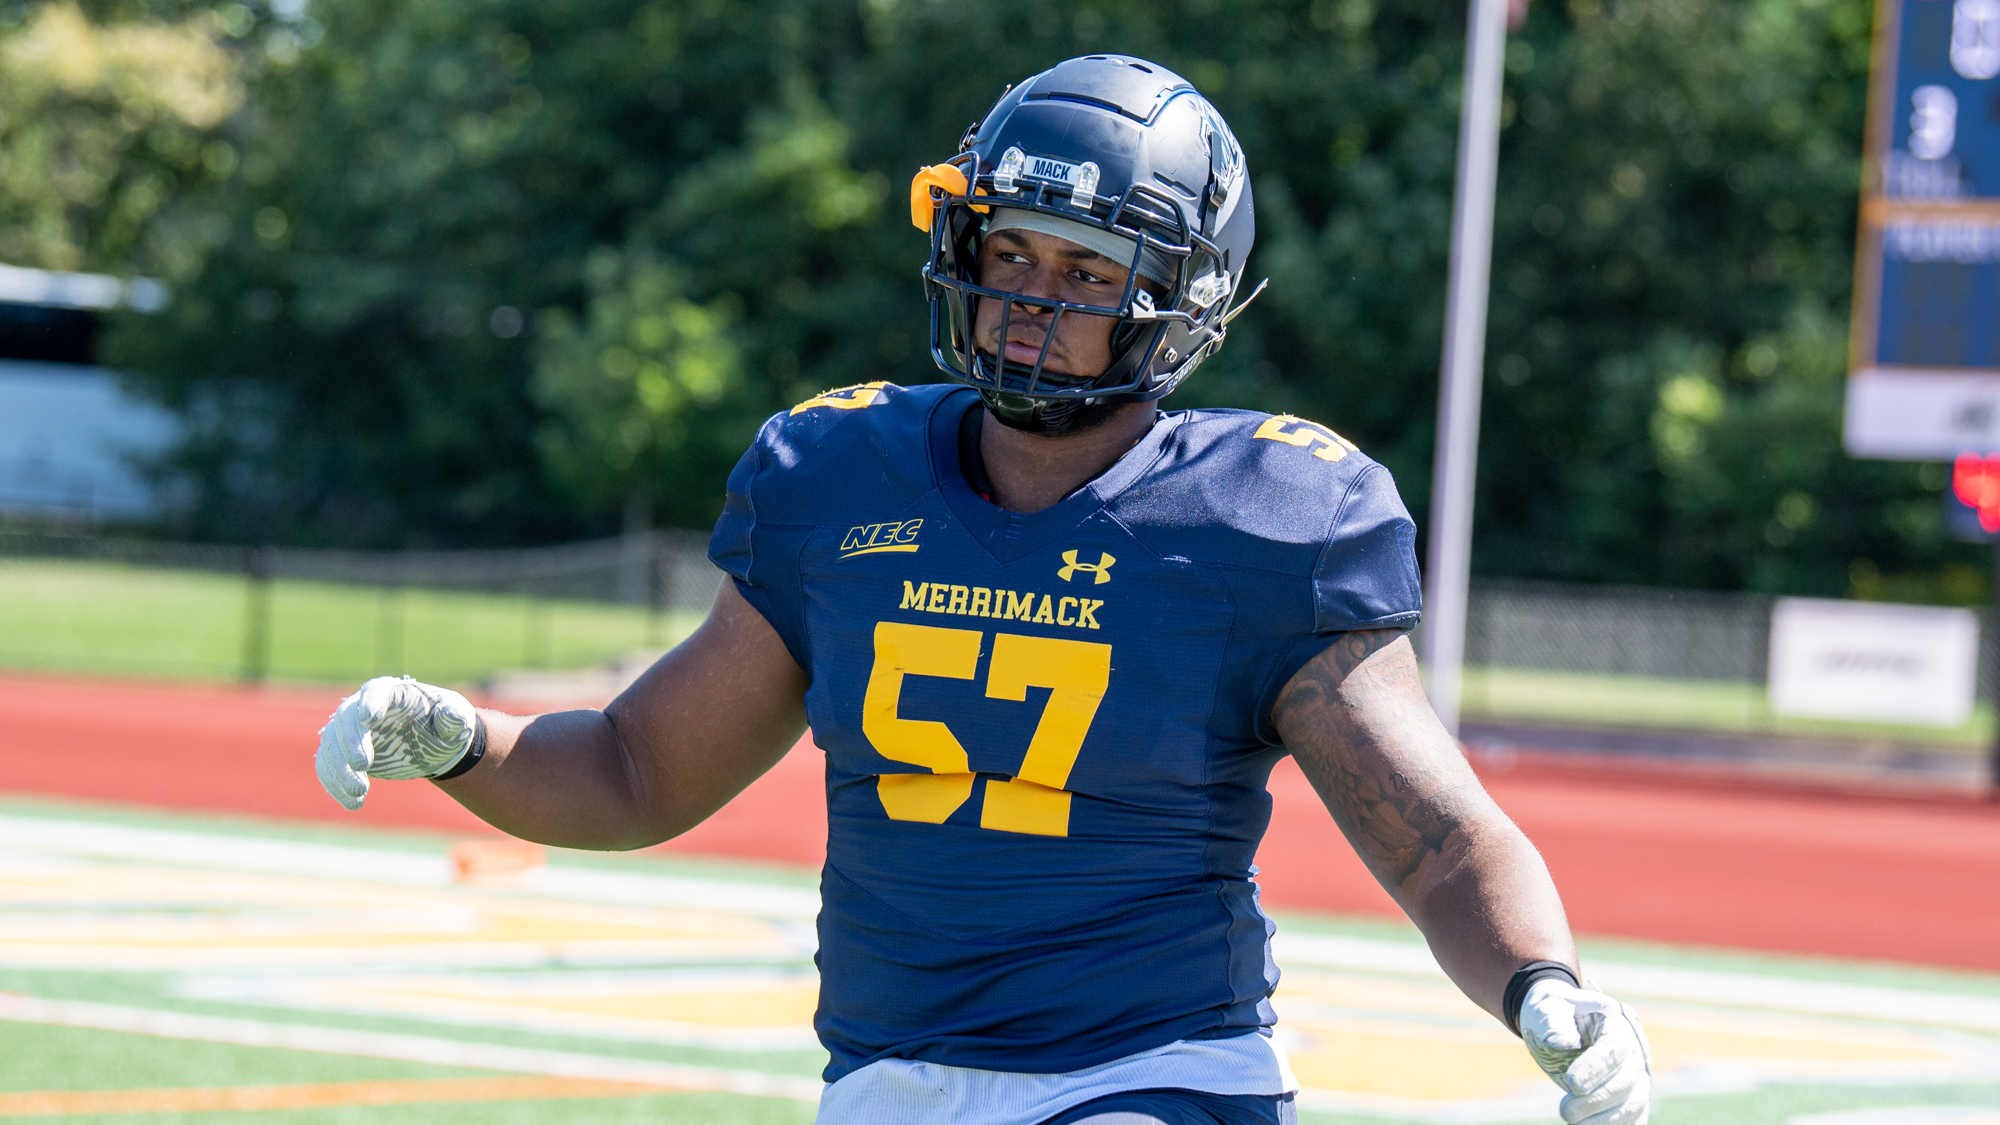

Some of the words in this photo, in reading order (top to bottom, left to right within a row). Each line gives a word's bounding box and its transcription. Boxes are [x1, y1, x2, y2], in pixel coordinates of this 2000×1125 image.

[1032, 159, 1072, 181] MACK
[1253, 413, 1360, 462] 5
[840, 518, 924, 551] NEC
[899, 580, 1104, 630] MERRIMACK
[862, 621, 1112, 837] 57
